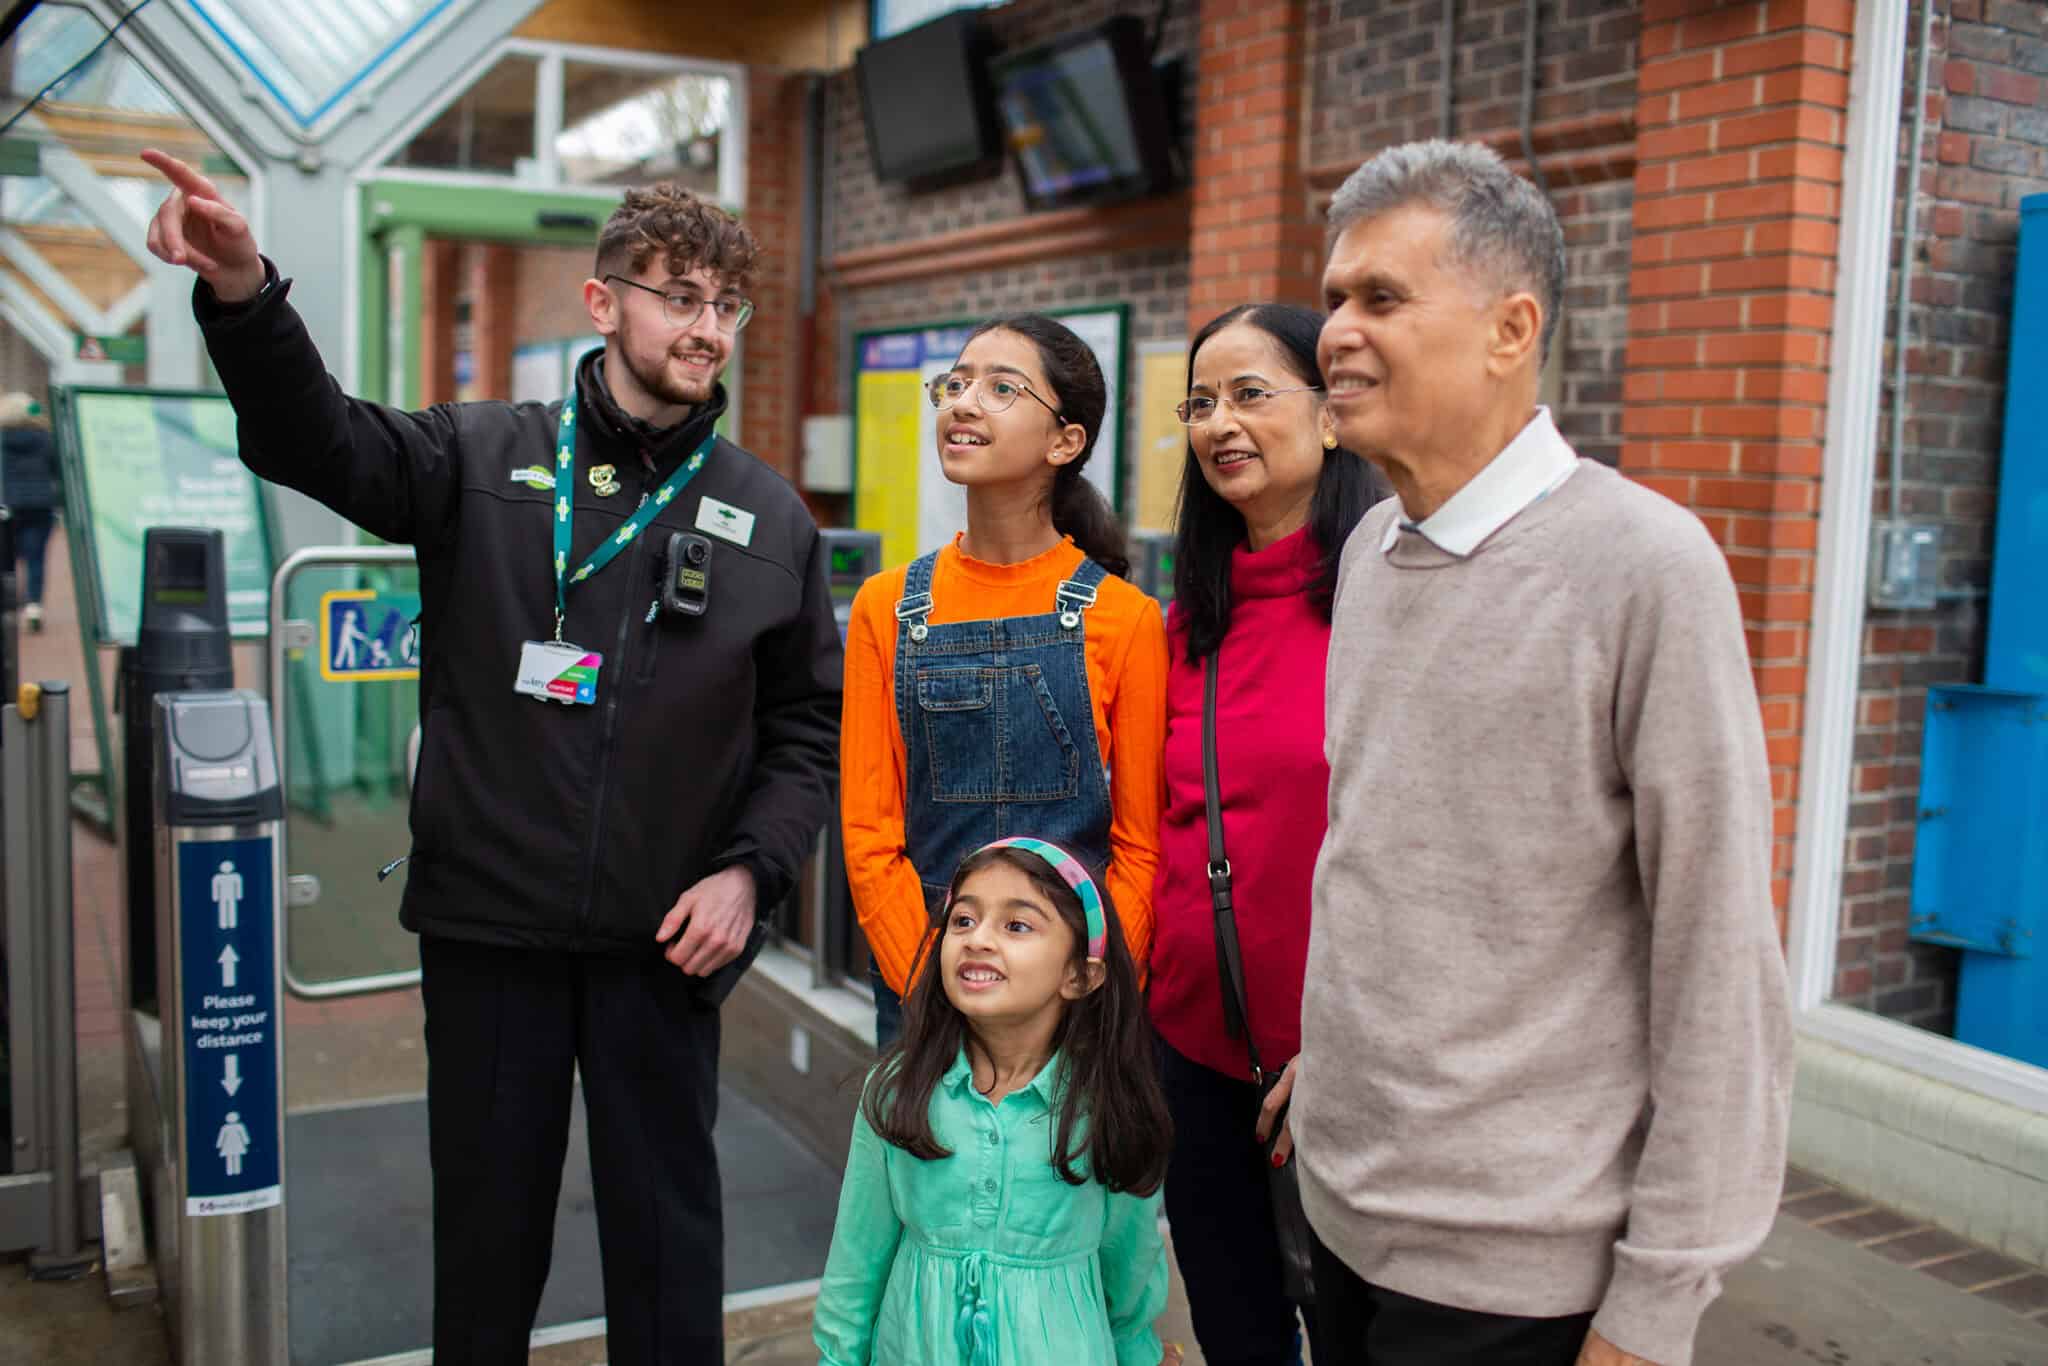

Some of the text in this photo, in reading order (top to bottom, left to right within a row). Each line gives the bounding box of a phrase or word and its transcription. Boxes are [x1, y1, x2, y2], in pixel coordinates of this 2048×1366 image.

[203, 994, 255, 1009] Please
[191, 1010, 267, 1031] keep your
[197, 1032, 262, 1049] distance
